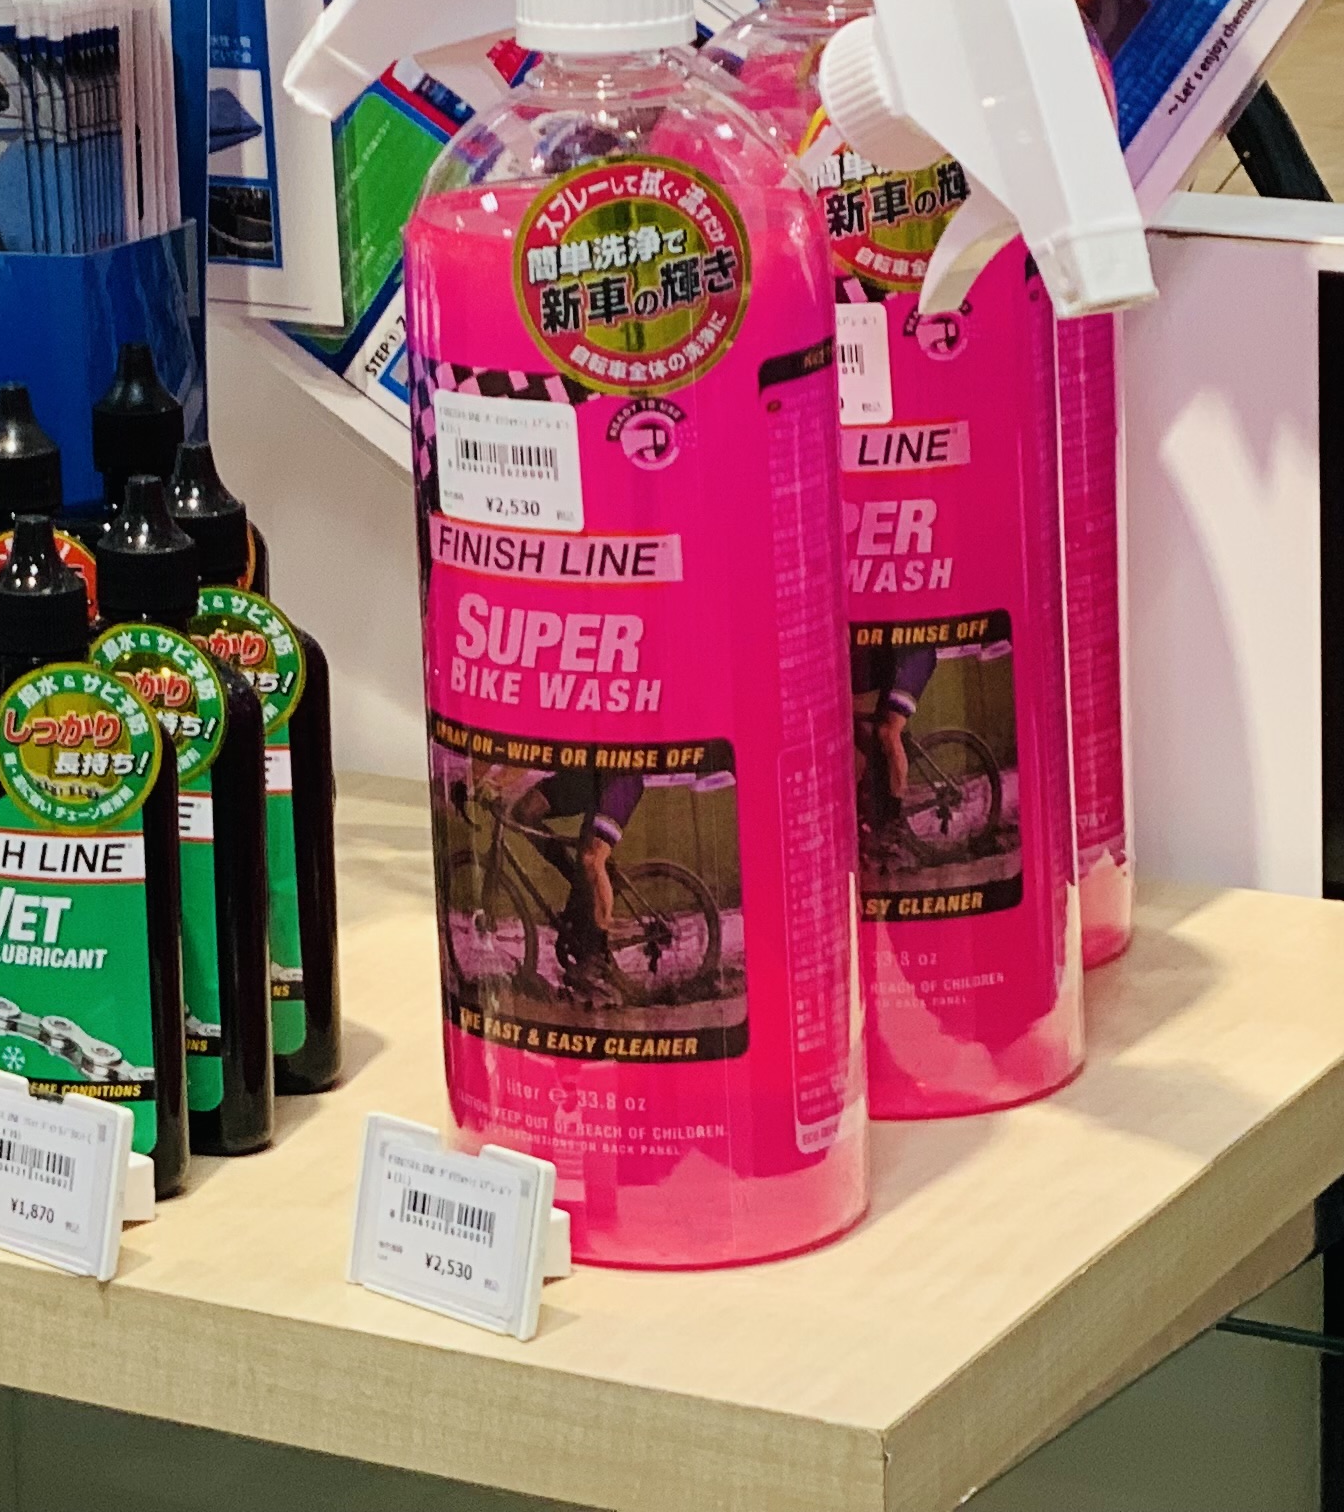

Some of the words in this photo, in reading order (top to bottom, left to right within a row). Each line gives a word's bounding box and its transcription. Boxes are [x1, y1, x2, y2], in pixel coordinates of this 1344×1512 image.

[527, 225, 688, 284] 簡単洗浄で
[541, 245, 737, 335] 新車の輝き
[569, 310, 728, 382] 自転車全体の洗浄に
[858, 429, 950, 466] LINE
[485, 496, 541, 517] ¥2,530
[438, 524, 544, 575] FINISH
[560, 541, 659, 577] LINE
[455, 592, 644, 674] SUPER
[857, 625, 886, 645] OR
[891, 622, 960, 644] RINSE
[964, 619, 988, 639] OFF
[450, 657, 521, 707] BIKE
[539, 671, 662, 713] WASH
[4, 710, 121, 747] しっかり
[54, 751, 149, 778] 長持ち!
[561, 745, 590, 766] OR
[595, 745, 661, 769] RINSE
[666, 745, 706, 768] OFF
[39, 843, 123, 873] LINE
[897, 892, 983, 914] CLEANER
[484, 1018, 523, 1044] FAST
[528, 1026, 540, 1046] &
[547, 1028, 598, 1055] EASY
[604, 1033, 699, 1058] CLEANER
[61, 1083, 141, 1097] CONDITIONS
[10, 1197, 55, 1225] ¥1,870
[425, 1251, 472, 1281] ¥2,530
